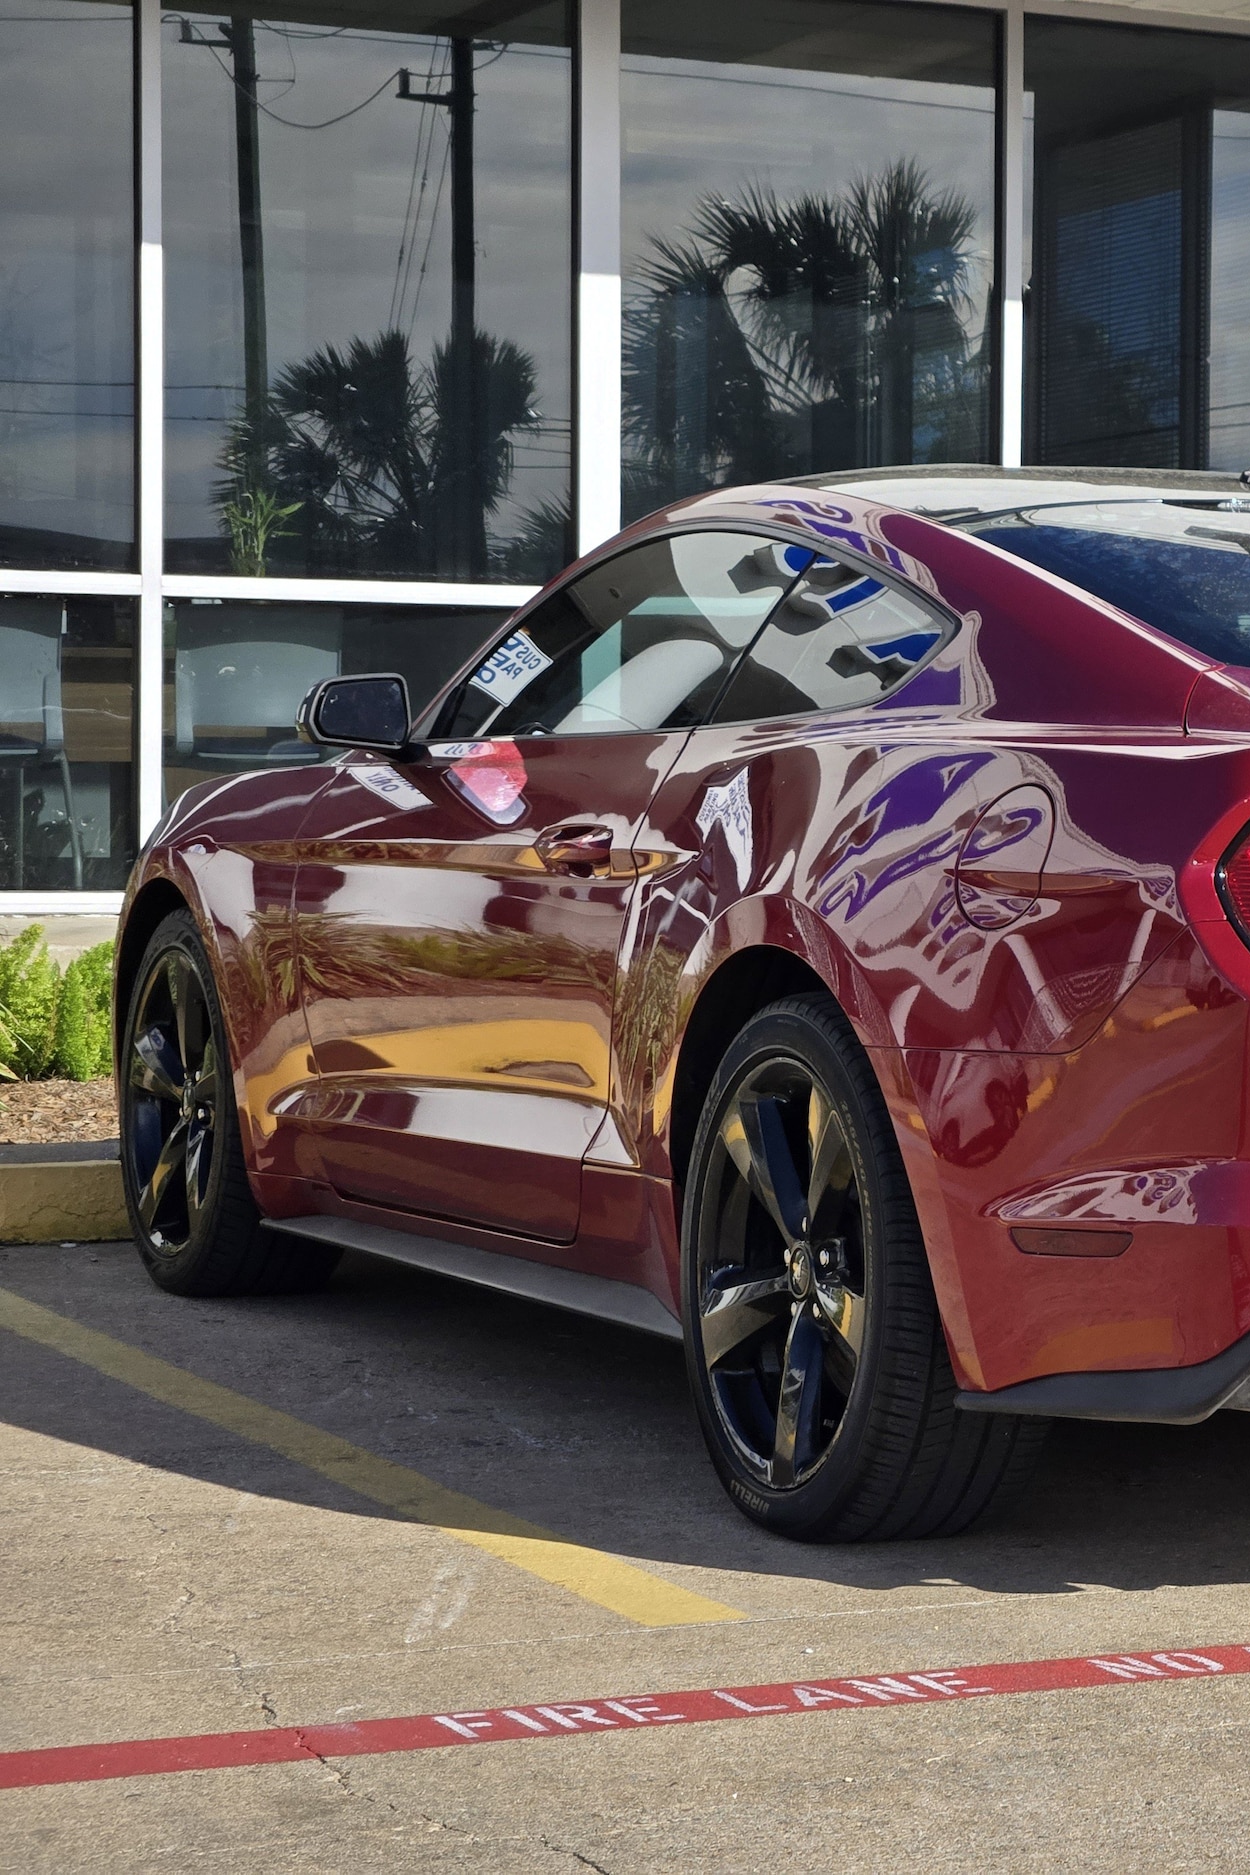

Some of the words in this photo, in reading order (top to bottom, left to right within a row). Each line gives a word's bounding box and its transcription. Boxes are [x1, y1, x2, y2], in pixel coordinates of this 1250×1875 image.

[433, 1697, 686, 1739] FIRE
[712, 1671, 994, 1713] LANE
[1086, 1652, 1224, 1680] NO
